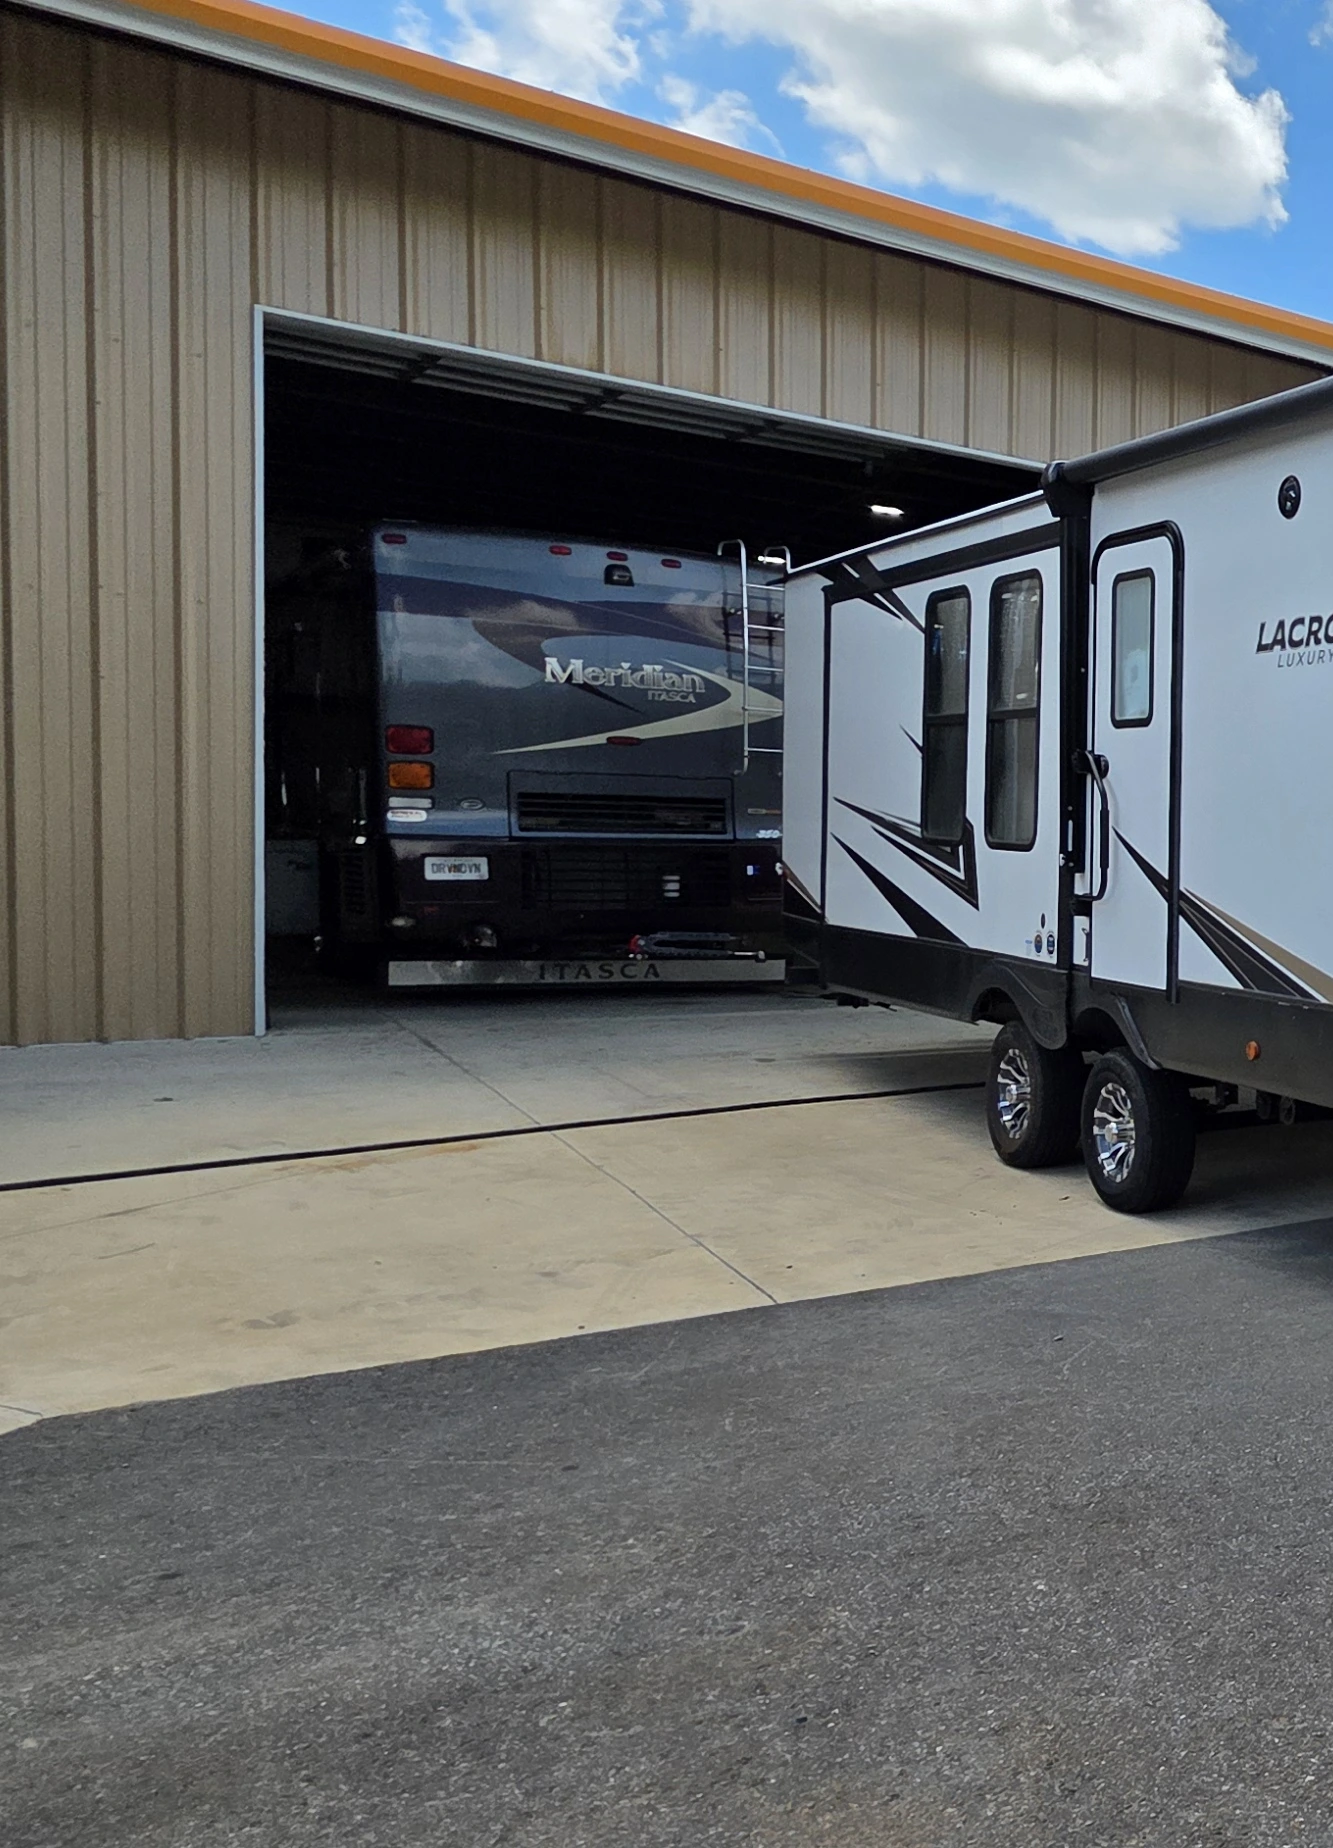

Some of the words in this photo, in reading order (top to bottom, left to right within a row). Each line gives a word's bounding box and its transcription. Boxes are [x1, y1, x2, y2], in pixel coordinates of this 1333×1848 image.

[544, 657, 706, 692] Meridian
[648, 690, 696, 703] ITASCA
[539, 962, 660, 980] ITASCA
